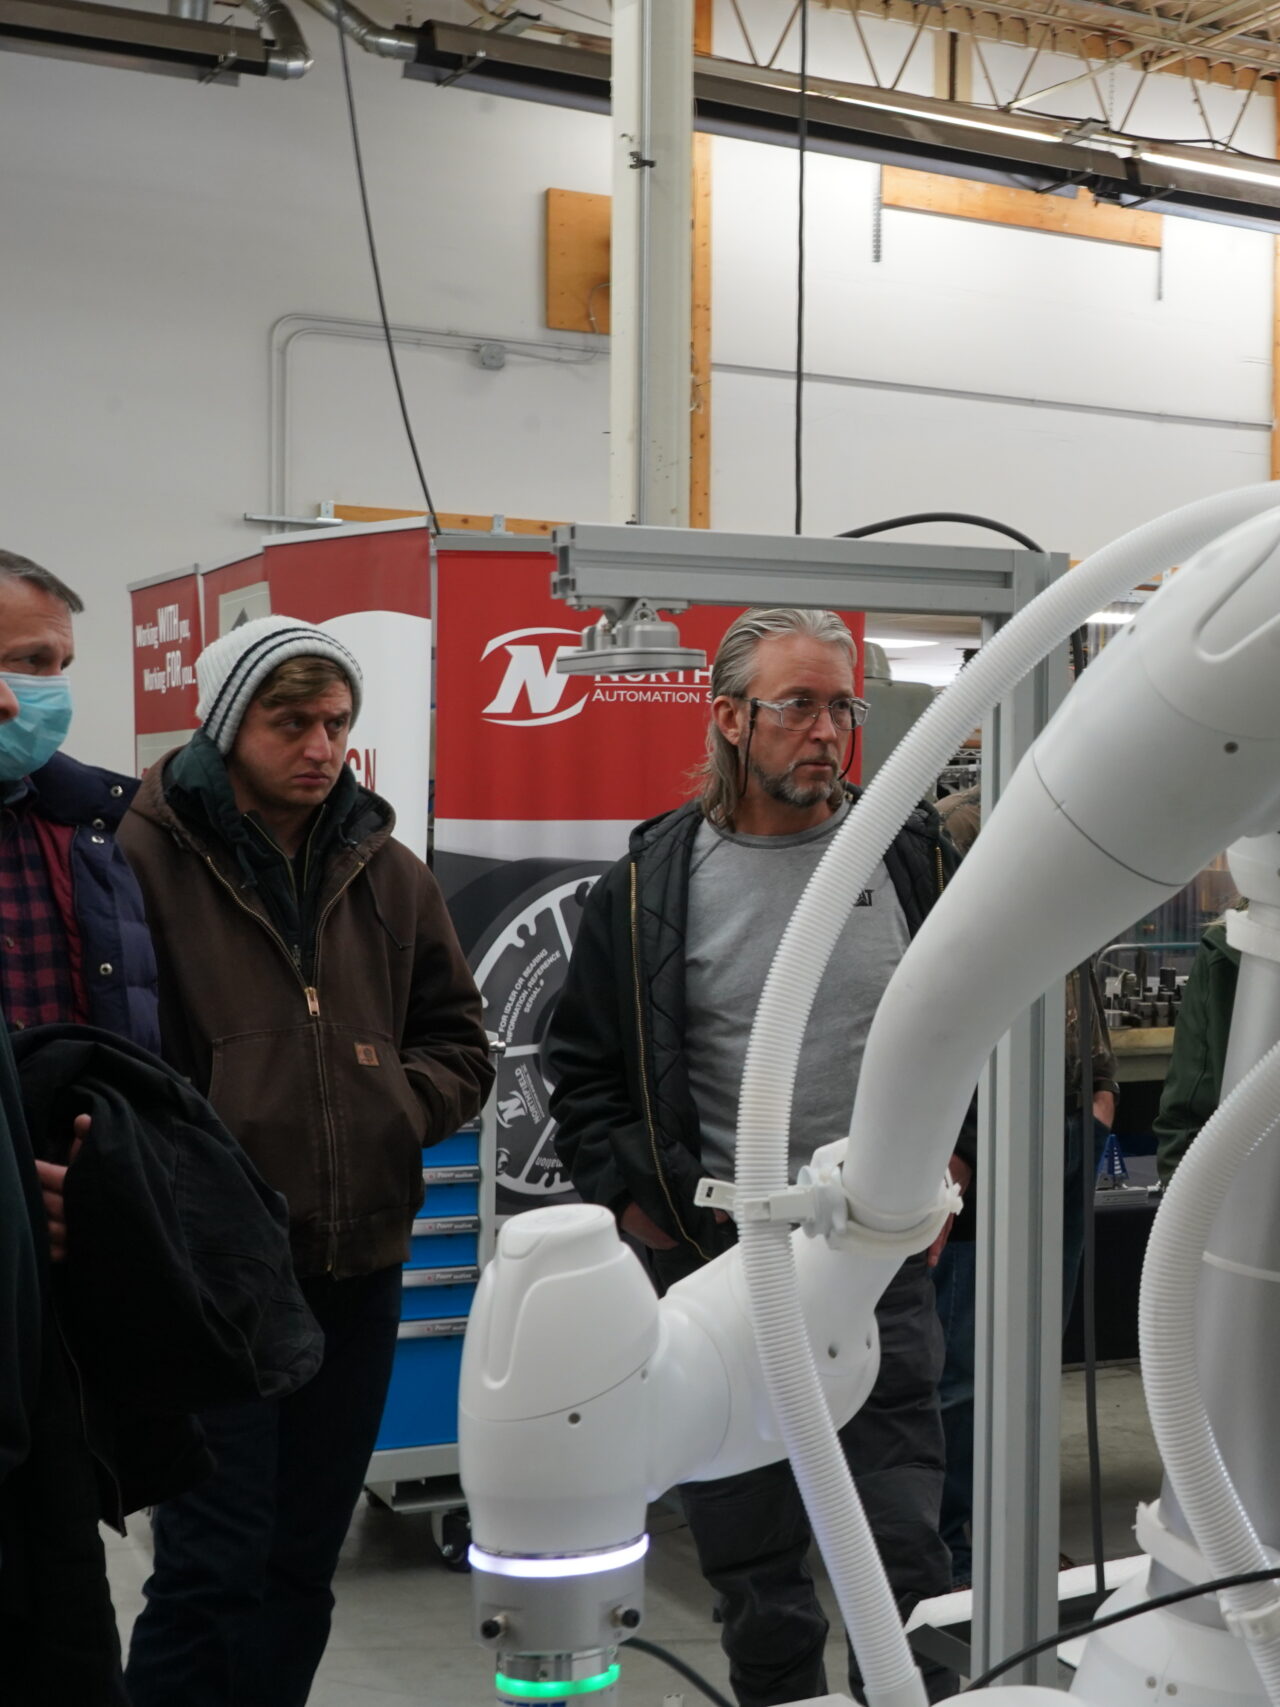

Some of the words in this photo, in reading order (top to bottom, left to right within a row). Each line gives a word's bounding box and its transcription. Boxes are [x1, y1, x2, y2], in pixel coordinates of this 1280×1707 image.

[135, 623, 158, 649] Working
[157, 604, 179, 643] WITH
[143, 667, 166, 694] Working
[166, 650, 182, 688] FOR
[592, 689, 700, 703] AUTOMATION
[853, 889, 875, 907] AT
[498, 1014, 509, 1033] FOR
[504, 989, 519, 1015] IDLER
[514, 977, 525, 991] OR
[522, 948, 548, 978] BEARING
[523, 987, 541, 1014] SERIAL
[515, 1067, 542, 1125] NORTHFIELD
